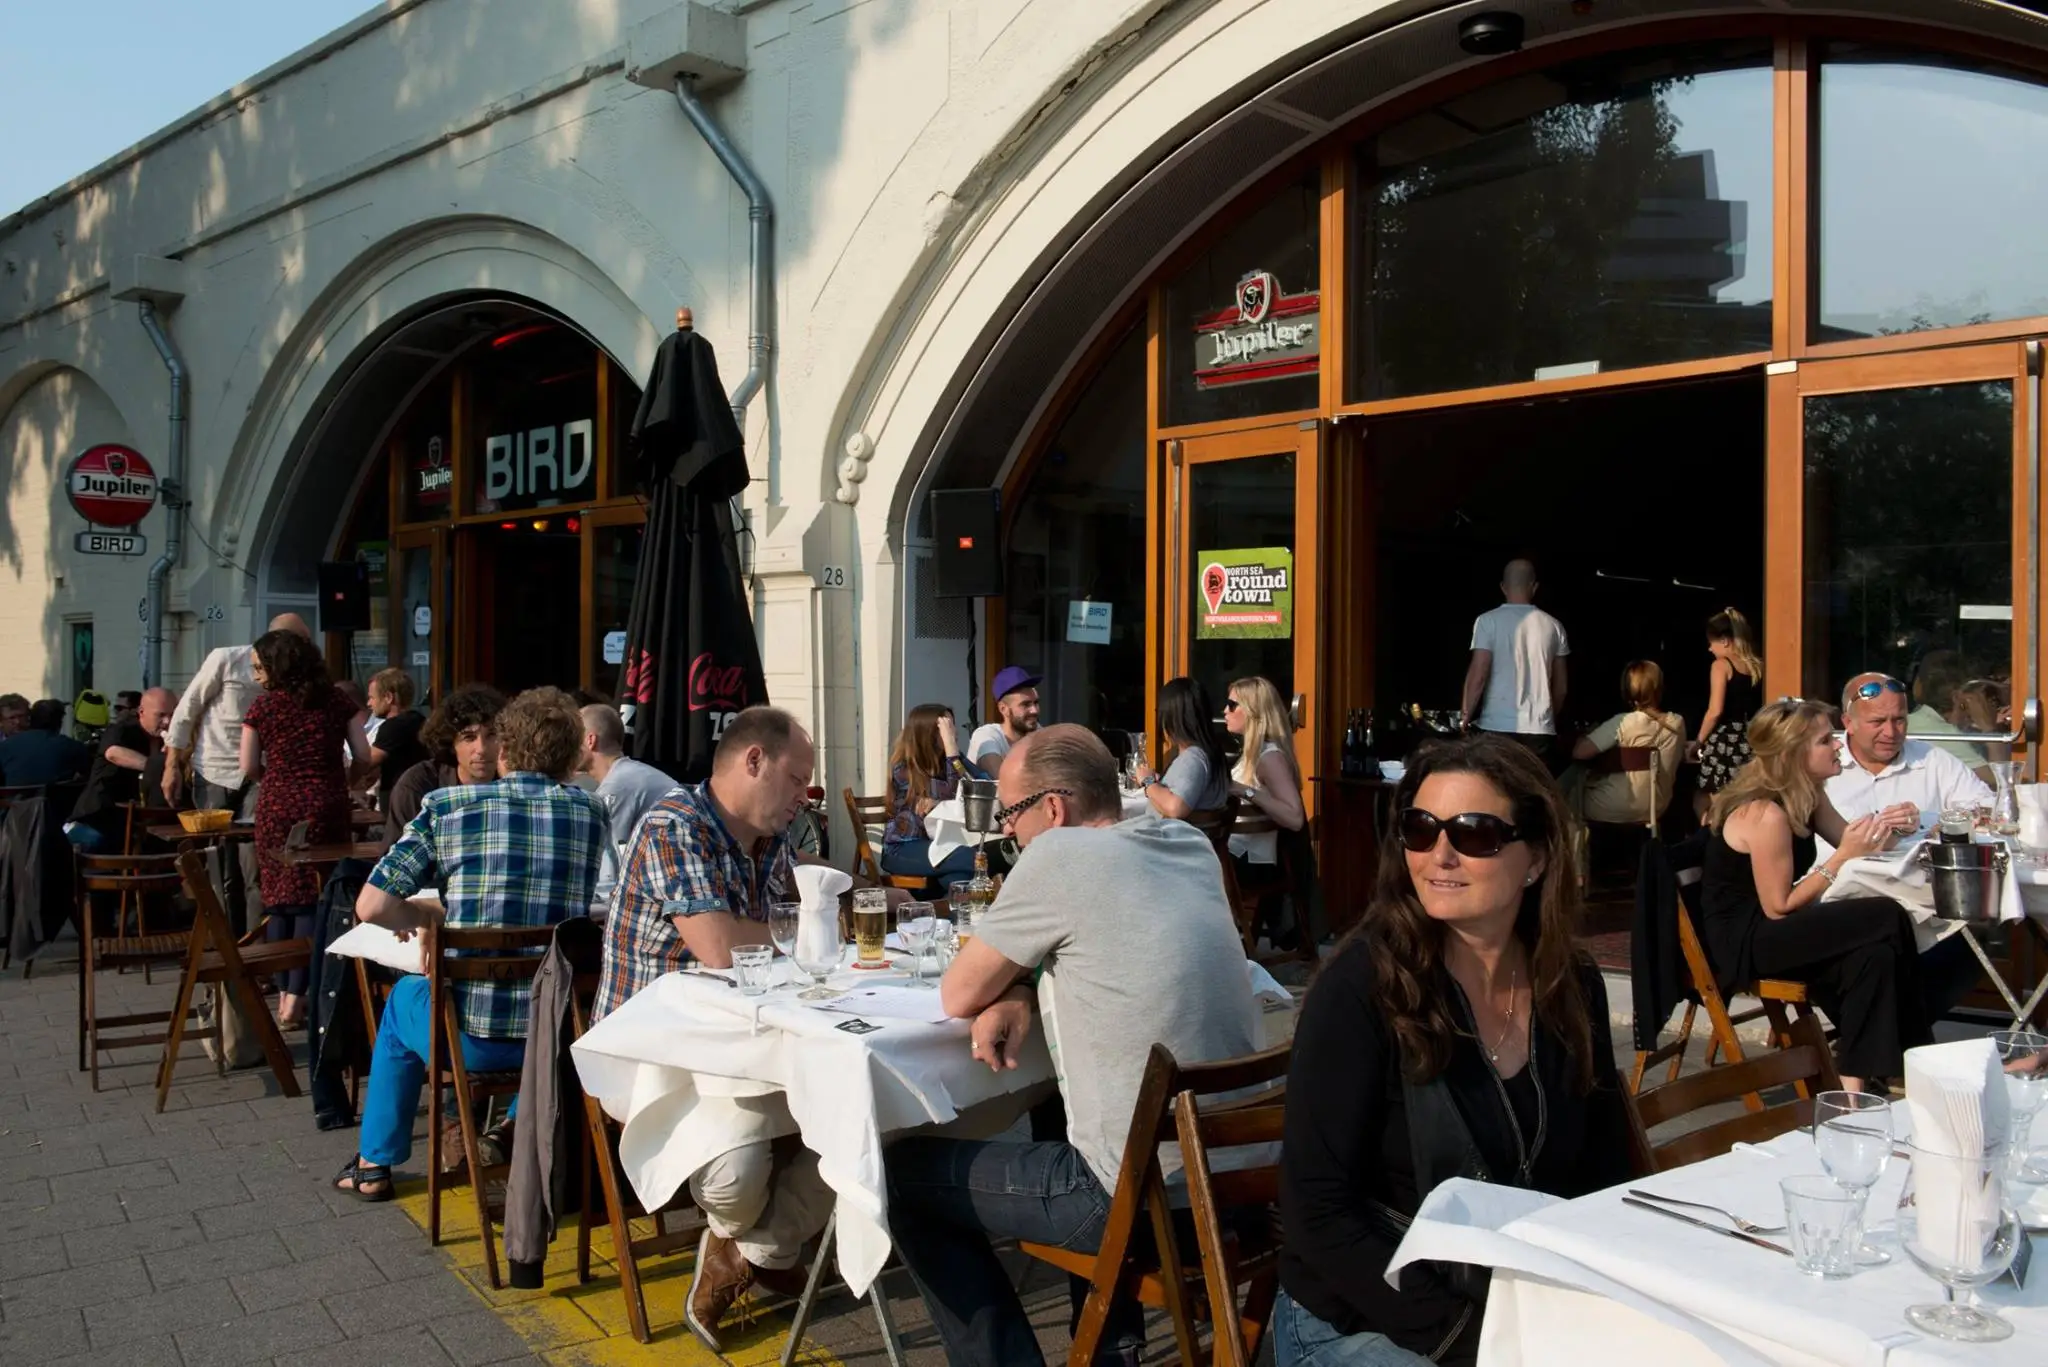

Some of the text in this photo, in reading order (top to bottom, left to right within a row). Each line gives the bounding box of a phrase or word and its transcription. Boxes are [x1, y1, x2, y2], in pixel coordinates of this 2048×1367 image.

[1209, 321, 1313, 365] Jupiler
[486, 418, 592, 500] BIRD
[79, 475, 152, 497] Jupiler
[90, 536, 134, 552] BIRD
[824, 567, 844, 586] 28
[1230, 569, 1287, 589] round
[1249, 566, 1264, 575] SEA
[1224, 586, 1271, 603] town
[207, 605, 224, 620] 26
